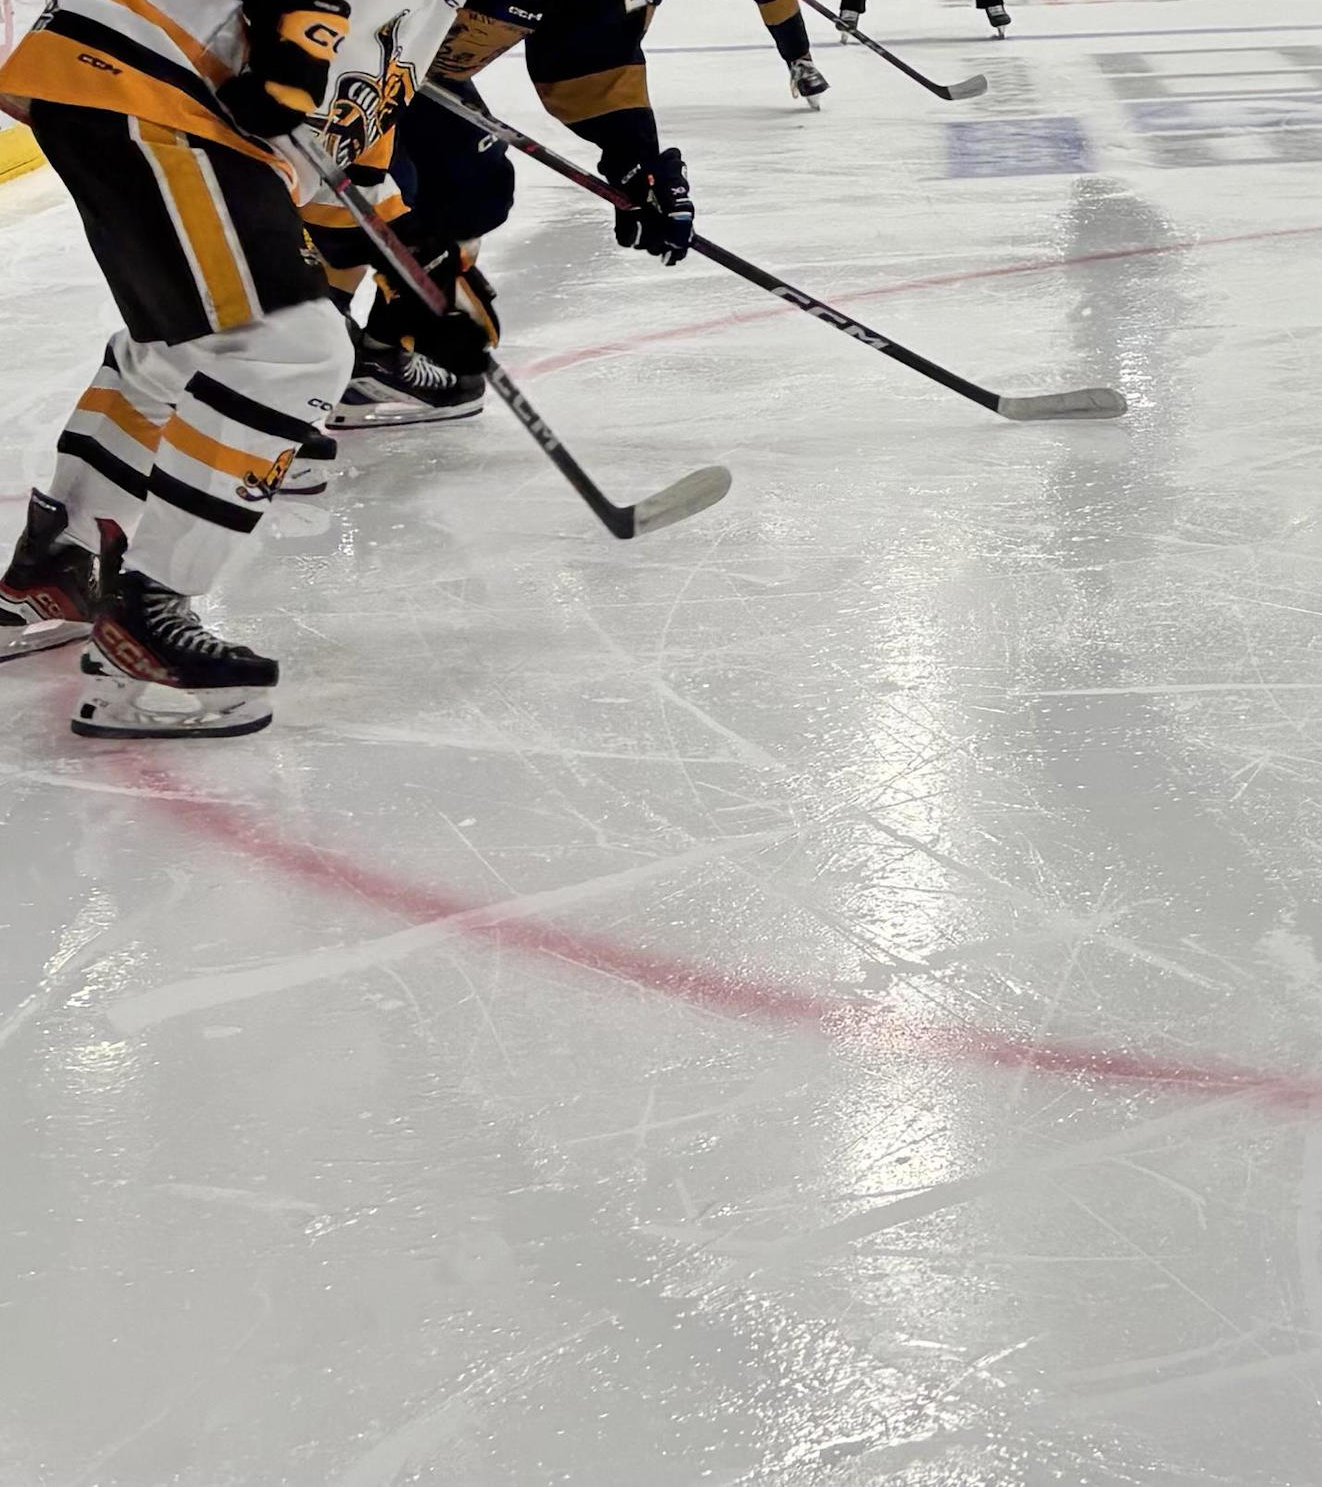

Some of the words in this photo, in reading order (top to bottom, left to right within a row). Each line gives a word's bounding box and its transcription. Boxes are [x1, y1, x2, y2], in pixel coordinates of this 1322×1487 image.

[508, 6, 543, 21] CCM
[77, 53, 123, 76] CCM
[771, 286, 889, 350] CCM
